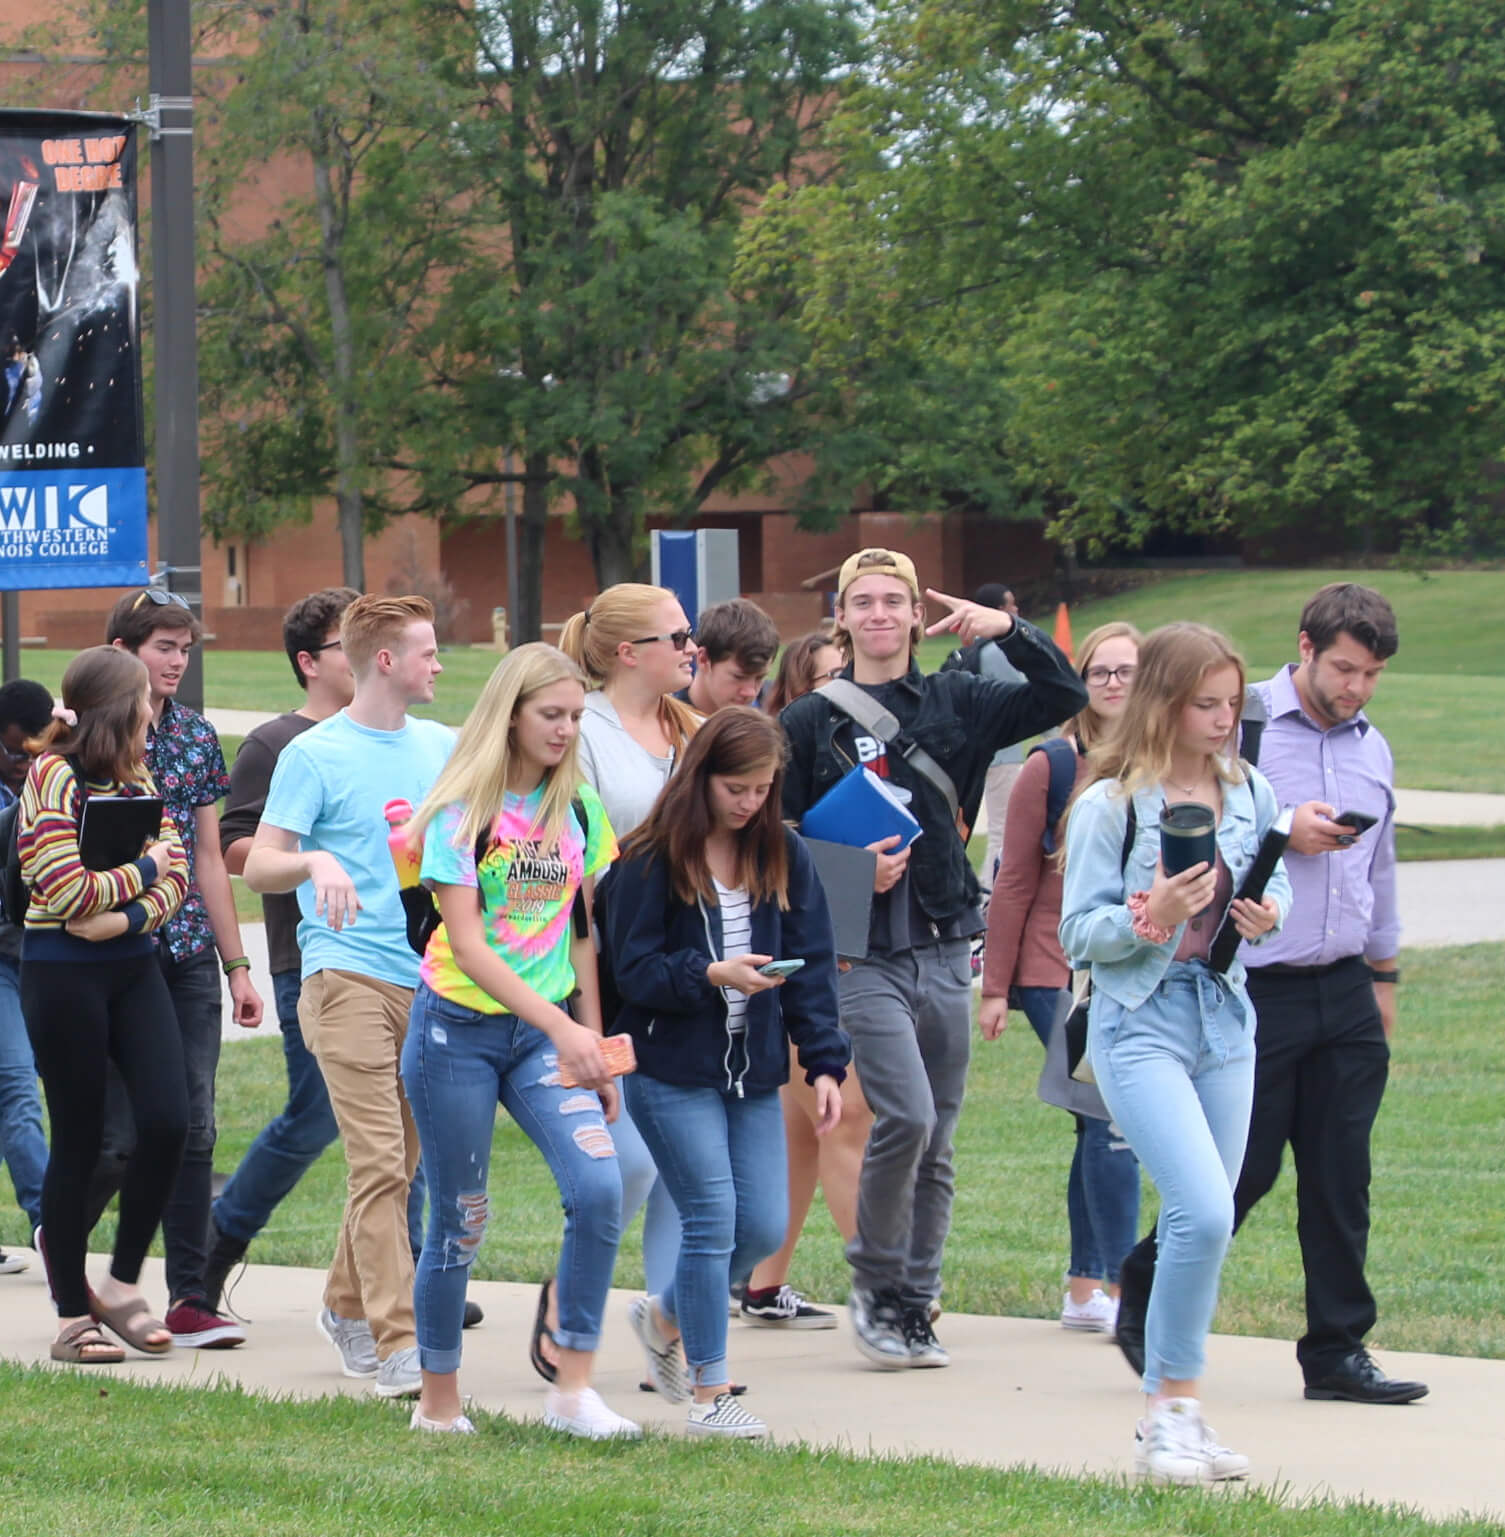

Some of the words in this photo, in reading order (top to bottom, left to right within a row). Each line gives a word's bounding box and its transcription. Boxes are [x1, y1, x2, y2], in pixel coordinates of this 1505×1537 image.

[41, 139, 84, 165] ONE
[84, 135, 127, 163] HOT
[54, 162, 122, 192] DEGRE
[39, 541, 109, 557] COLLEGE
[507, 860, 567, 884] AMBUSH
[507, 882, 563, 901] CLASSIC
